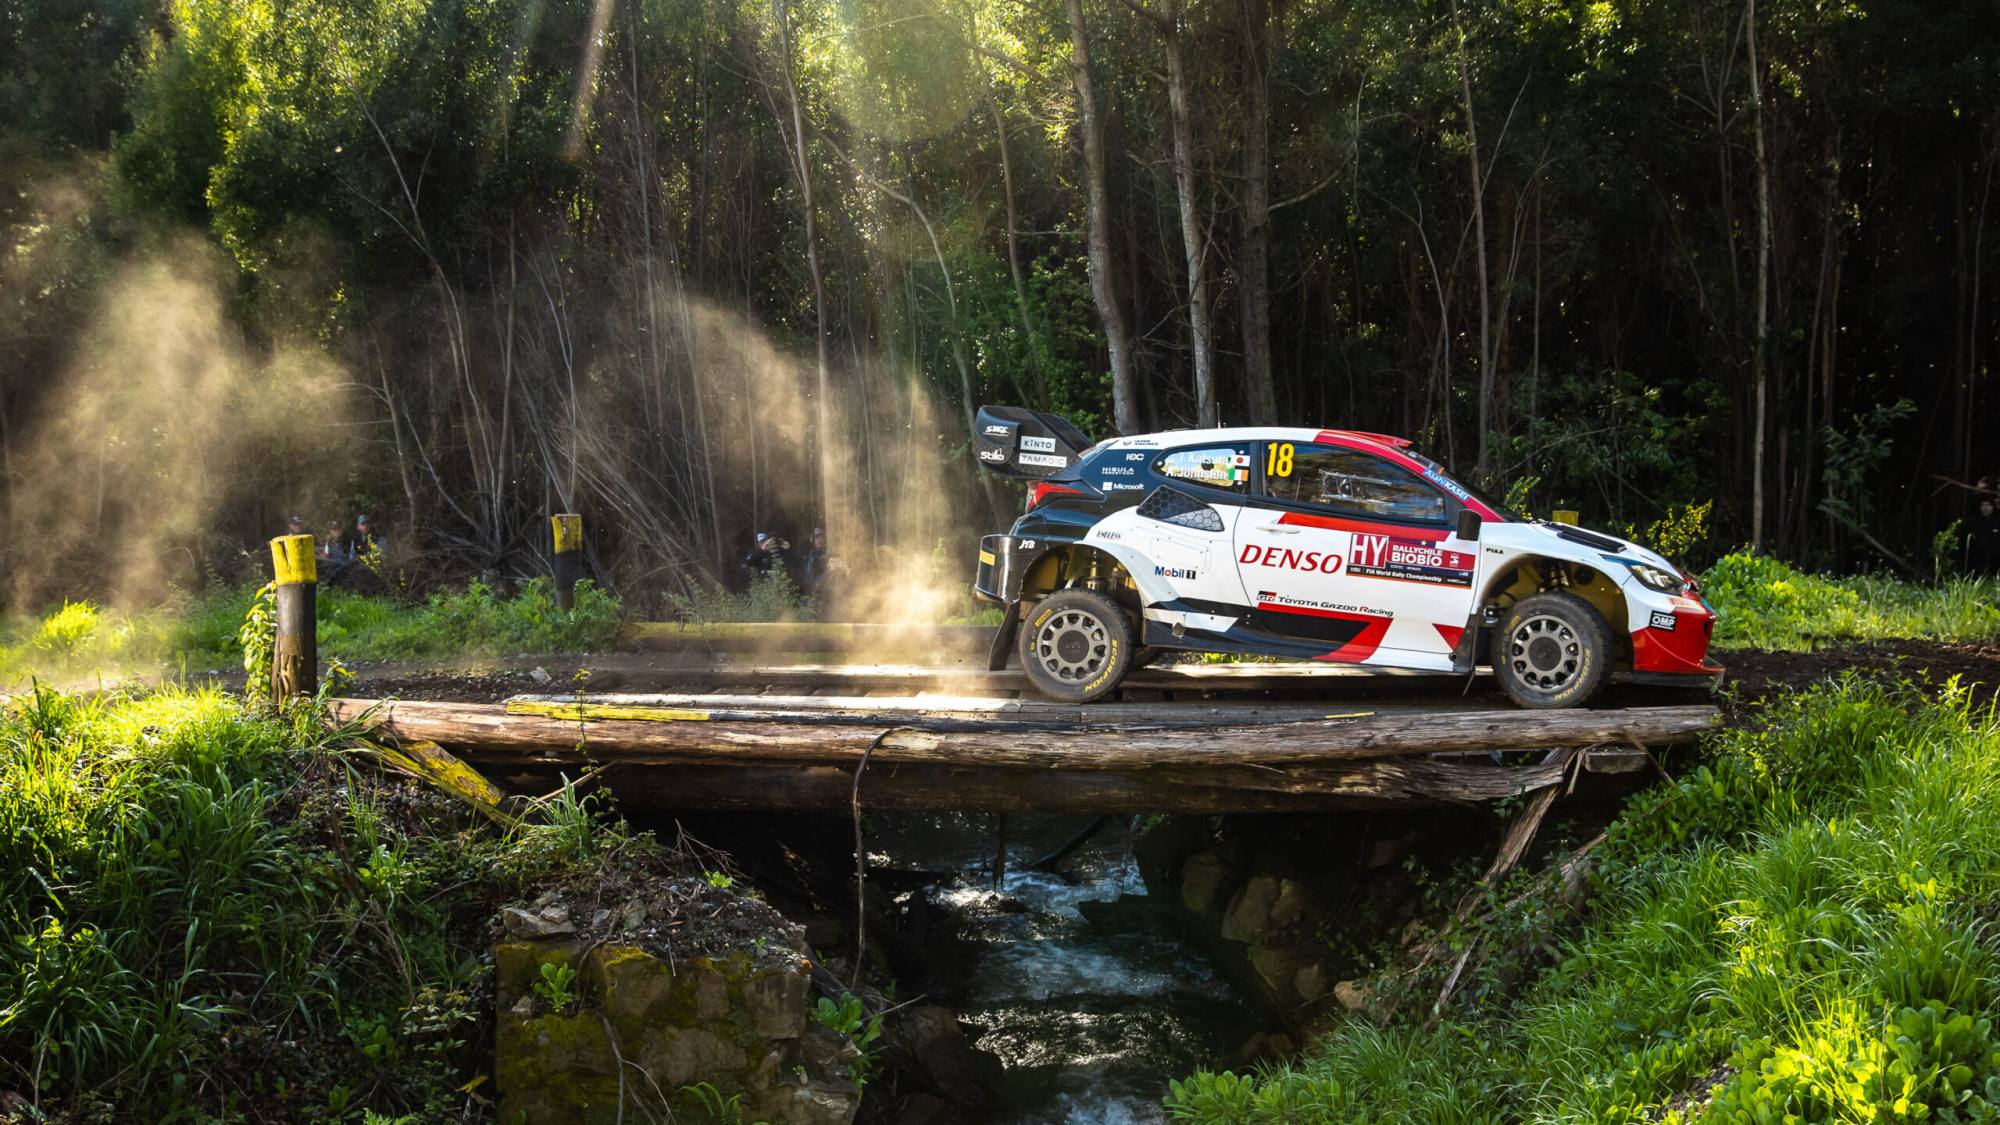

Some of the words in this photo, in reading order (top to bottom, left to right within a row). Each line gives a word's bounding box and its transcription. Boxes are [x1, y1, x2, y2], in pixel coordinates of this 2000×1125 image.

[1021, 454, 1064, 465] TAMADIC
[1267, 442, 1295, 477] 18
[1096, 531, 1121, 539] ENDLESS
[1019, 540, 1036, 549] JTB
[1349, 533, 1388, 567] HY
[1239, 544, 1343, 574] DENSO
[1154, 566, 1185, 579] Mobil
[1406, 573, 1442, 582] Championship
[1278, 596, 1319, 607] TOYOTA
[1320, 601, 1357, 612] GAZOO
[1359, 606, 1394, 617] Racing
[1652, 616, 1675, 628] OMP
[1084, 640, 1119, 692] SCORPION
